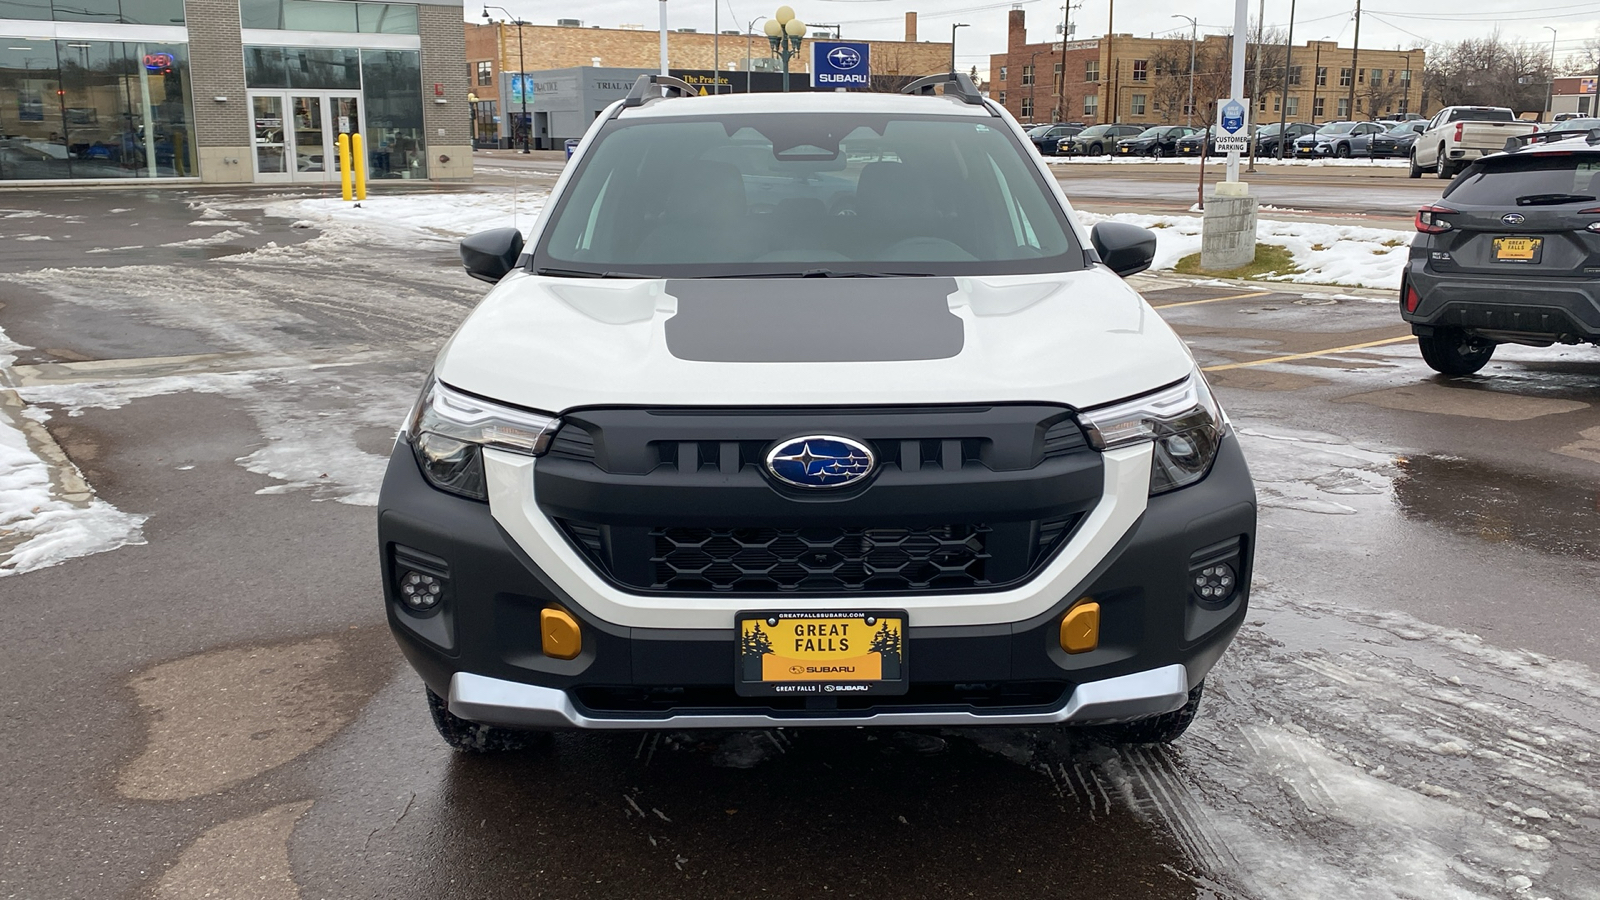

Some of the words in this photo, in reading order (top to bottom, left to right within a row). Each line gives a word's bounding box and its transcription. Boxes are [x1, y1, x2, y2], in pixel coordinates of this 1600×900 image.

[143, 55, 170, 66] OPEN
[683, 75, 697, 84] The
[699, 75, 728, 85] Pracice
[819, 74, 867, 83] SUBARU
[597, 82, 622, 90] TRIAL
[623, 82, 635, 90] AT
[795, 624, 849, 636] GREAT
[795, 638, 849, 652] FALLS
